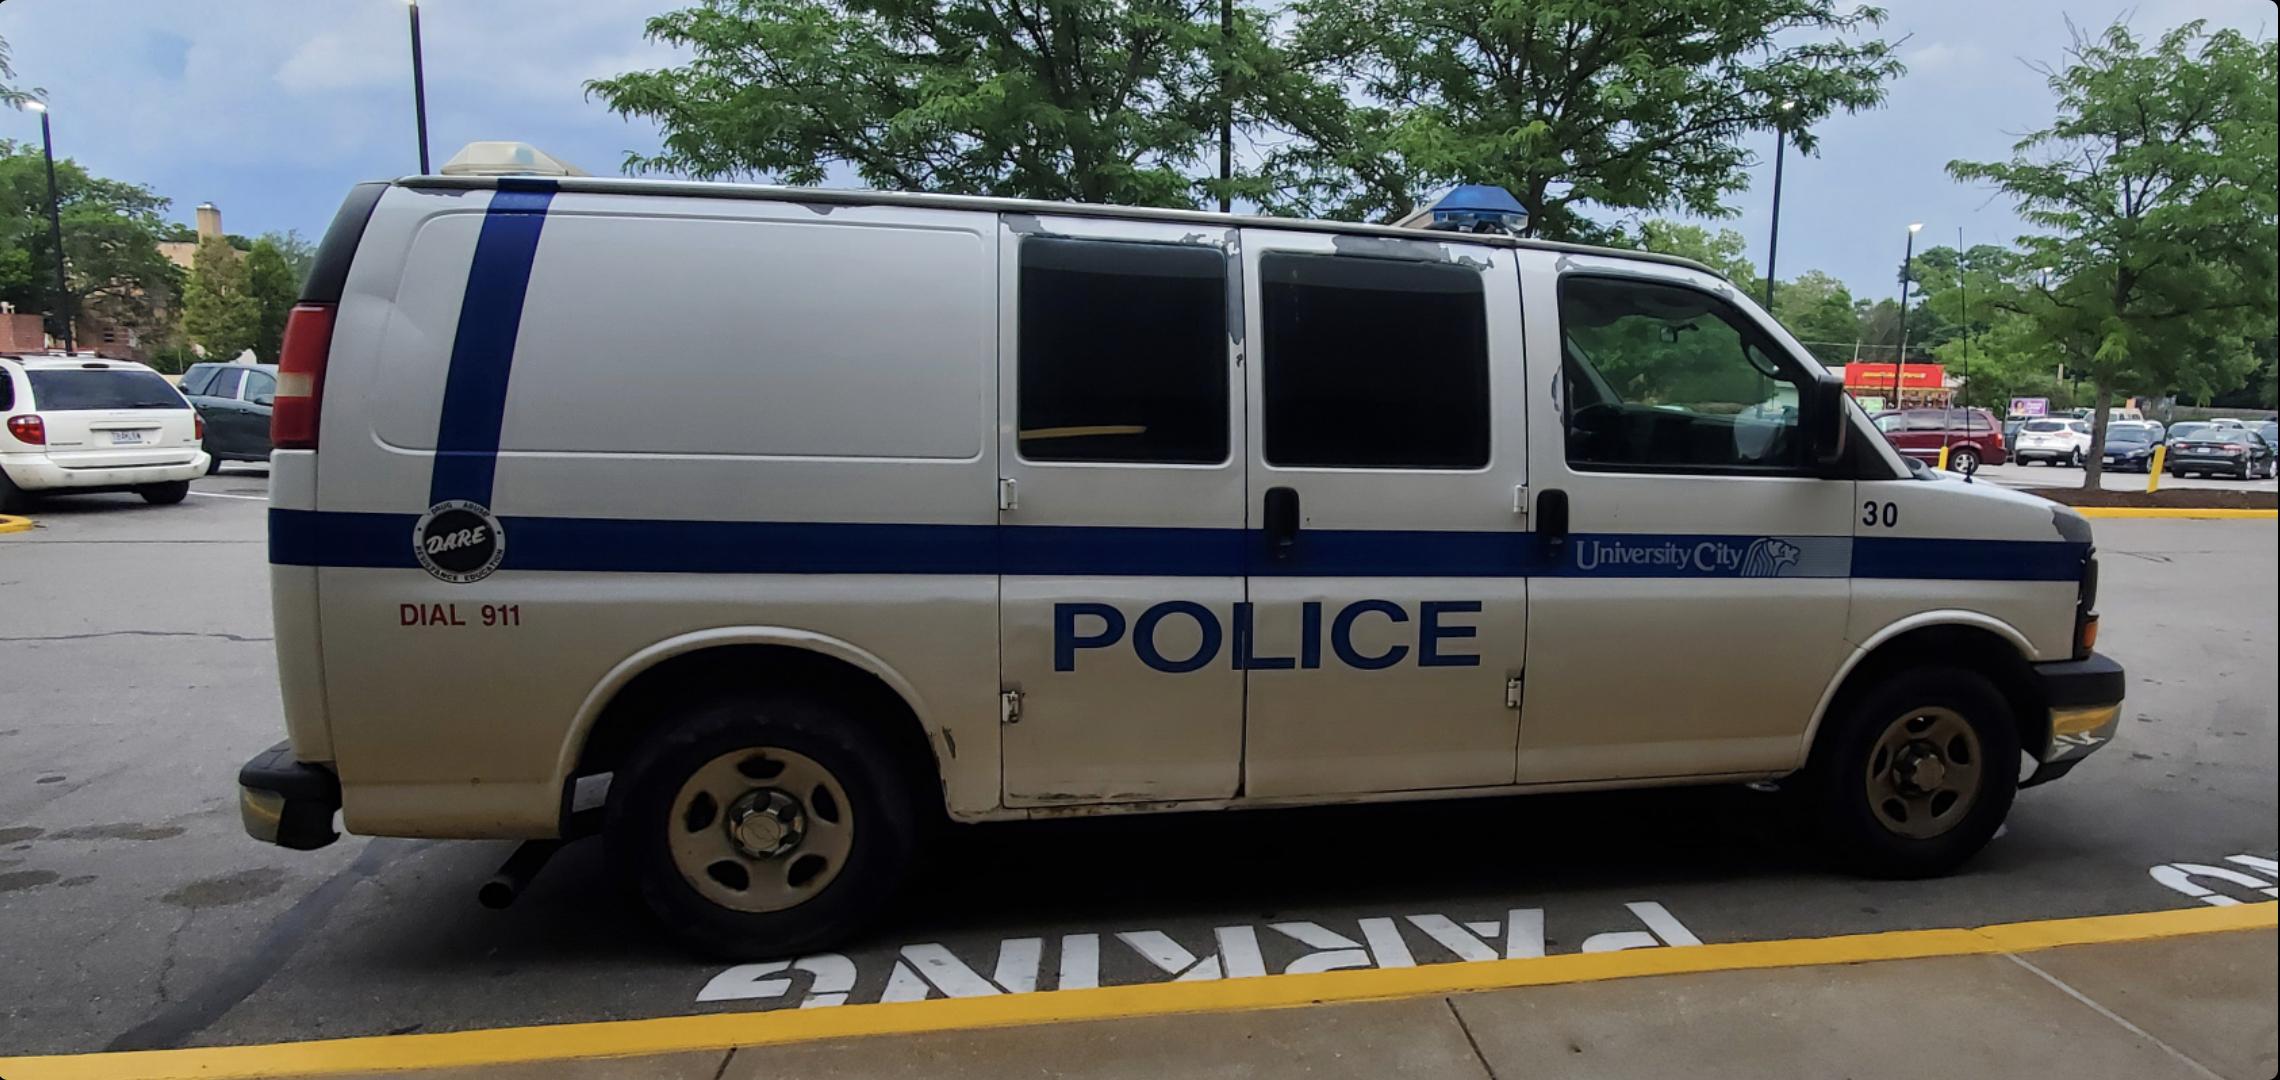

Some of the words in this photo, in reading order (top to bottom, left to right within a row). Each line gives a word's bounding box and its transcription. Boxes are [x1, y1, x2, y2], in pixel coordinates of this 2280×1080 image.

[1862, 500, 1898, 528] 30
[1576, 540, 1692, 571] University
[1694, 542, 1743, 571] City
[400, 603, 466, 627] DIAL
[481, 604, 520, 627] 911
[1054, 599, 1482, 674] POLICE
